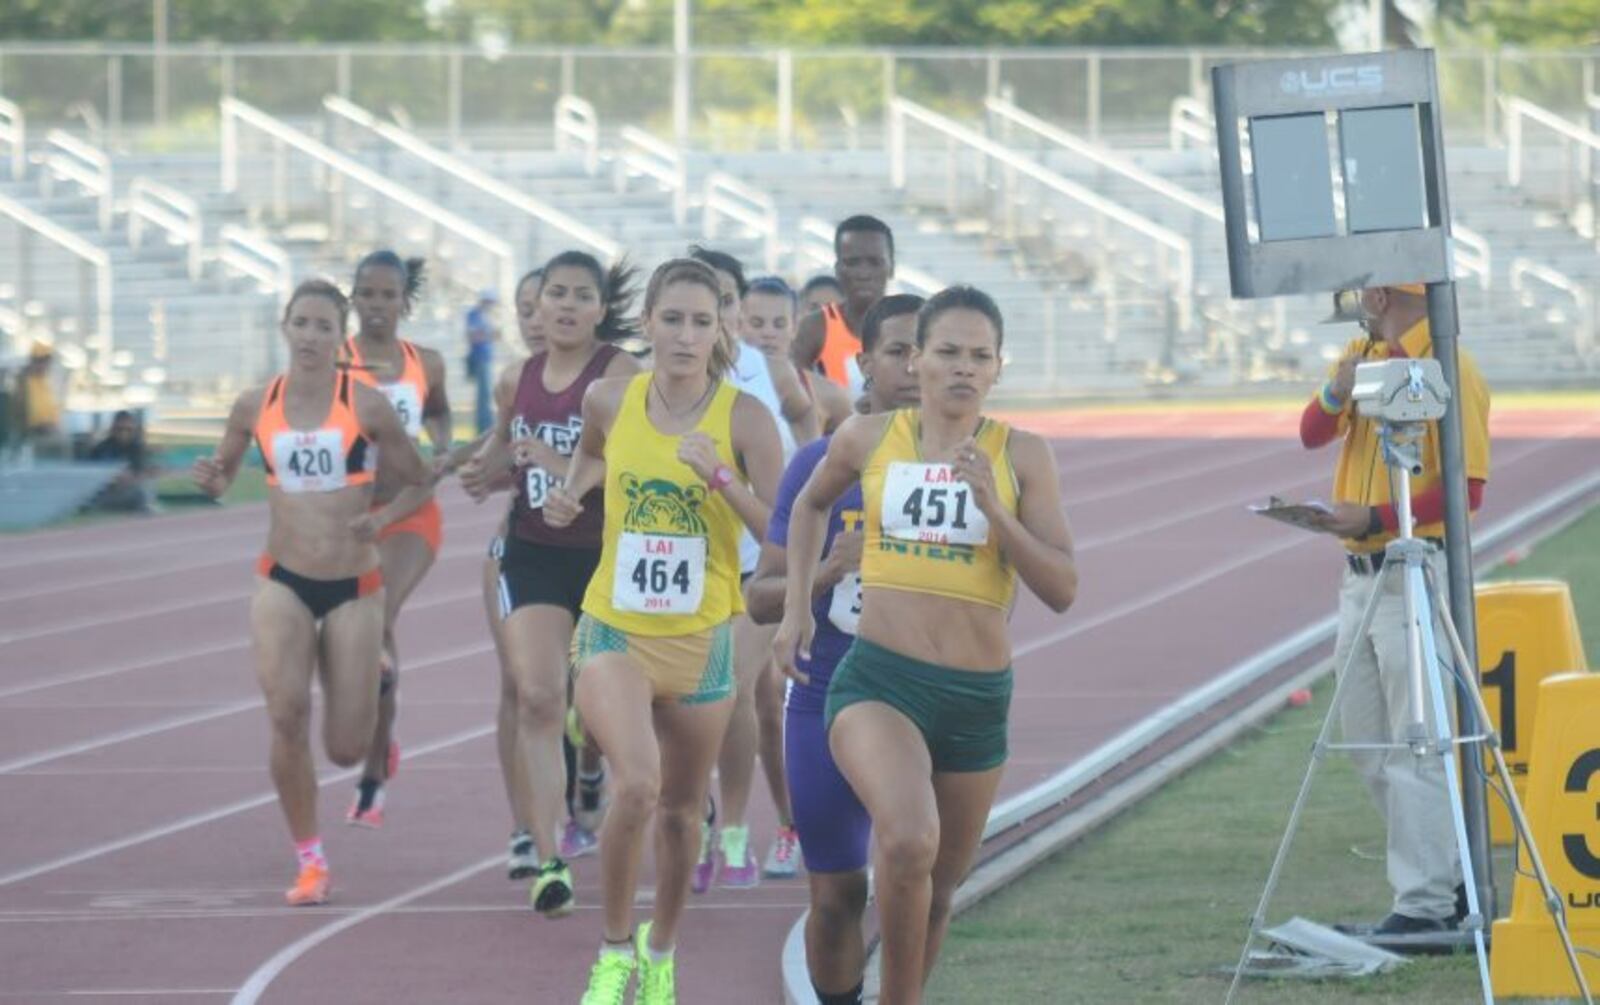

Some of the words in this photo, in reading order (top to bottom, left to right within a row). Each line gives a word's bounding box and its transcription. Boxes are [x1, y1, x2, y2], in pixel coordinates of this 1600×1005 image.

[1299, 65, 1383, 91] UCS
[287, 448, 332, 476] 420
[902, 487, 967, 530] 451
[645, 539, 674, 555] LAI
[917, 531, 948, 544] 2014
[631, 557, 690, 595] 464
[644, 598, 671, 608] 2014
[1481, 651, 1517, 752] 1
[1568, 892, 1600, 908] U
